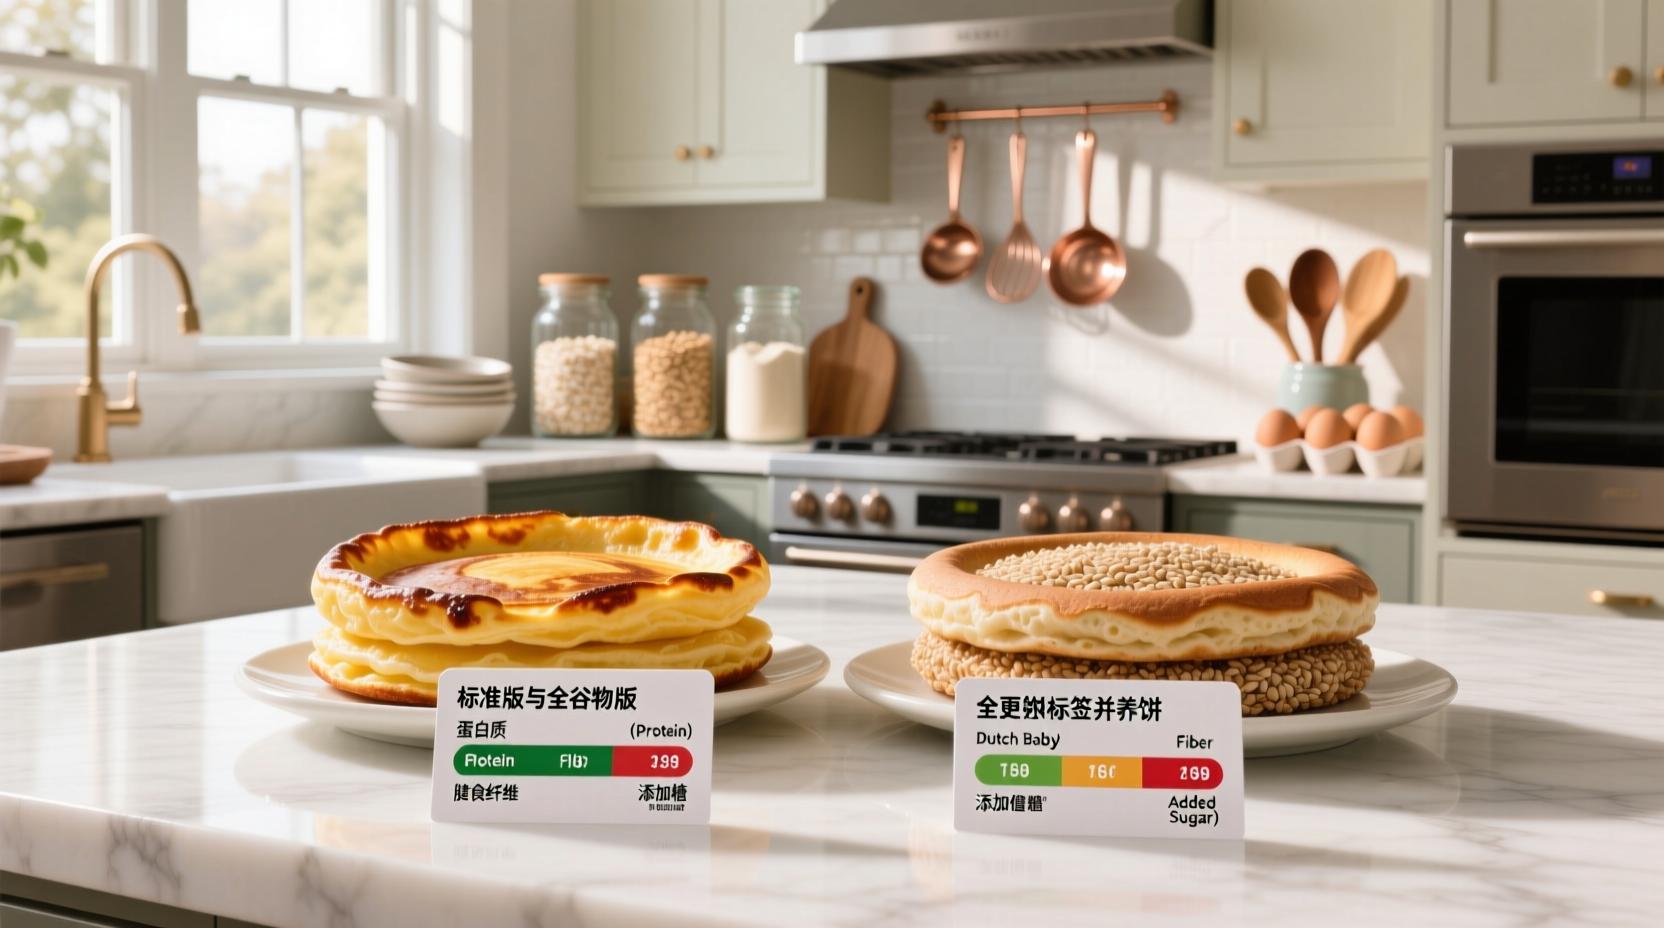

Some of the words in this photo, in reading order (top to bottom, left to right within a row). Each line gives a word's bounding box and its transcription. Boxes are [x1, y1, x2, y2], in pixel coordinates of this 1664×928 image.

[457, 686, 637, 710] 标准版与全谷物版
[457, 720, 506, 739] 蛋白质
[631, 723, 692, 740] (Protein)
[977, 732, 1018, 745] Dutch
[1024, 732, 1060, 750] Baby
[1177, 735, 1212, 749] Fiber
[1168, 795, 1215, 809] Added
[1170, 811, 1218, 827] Sugar)
